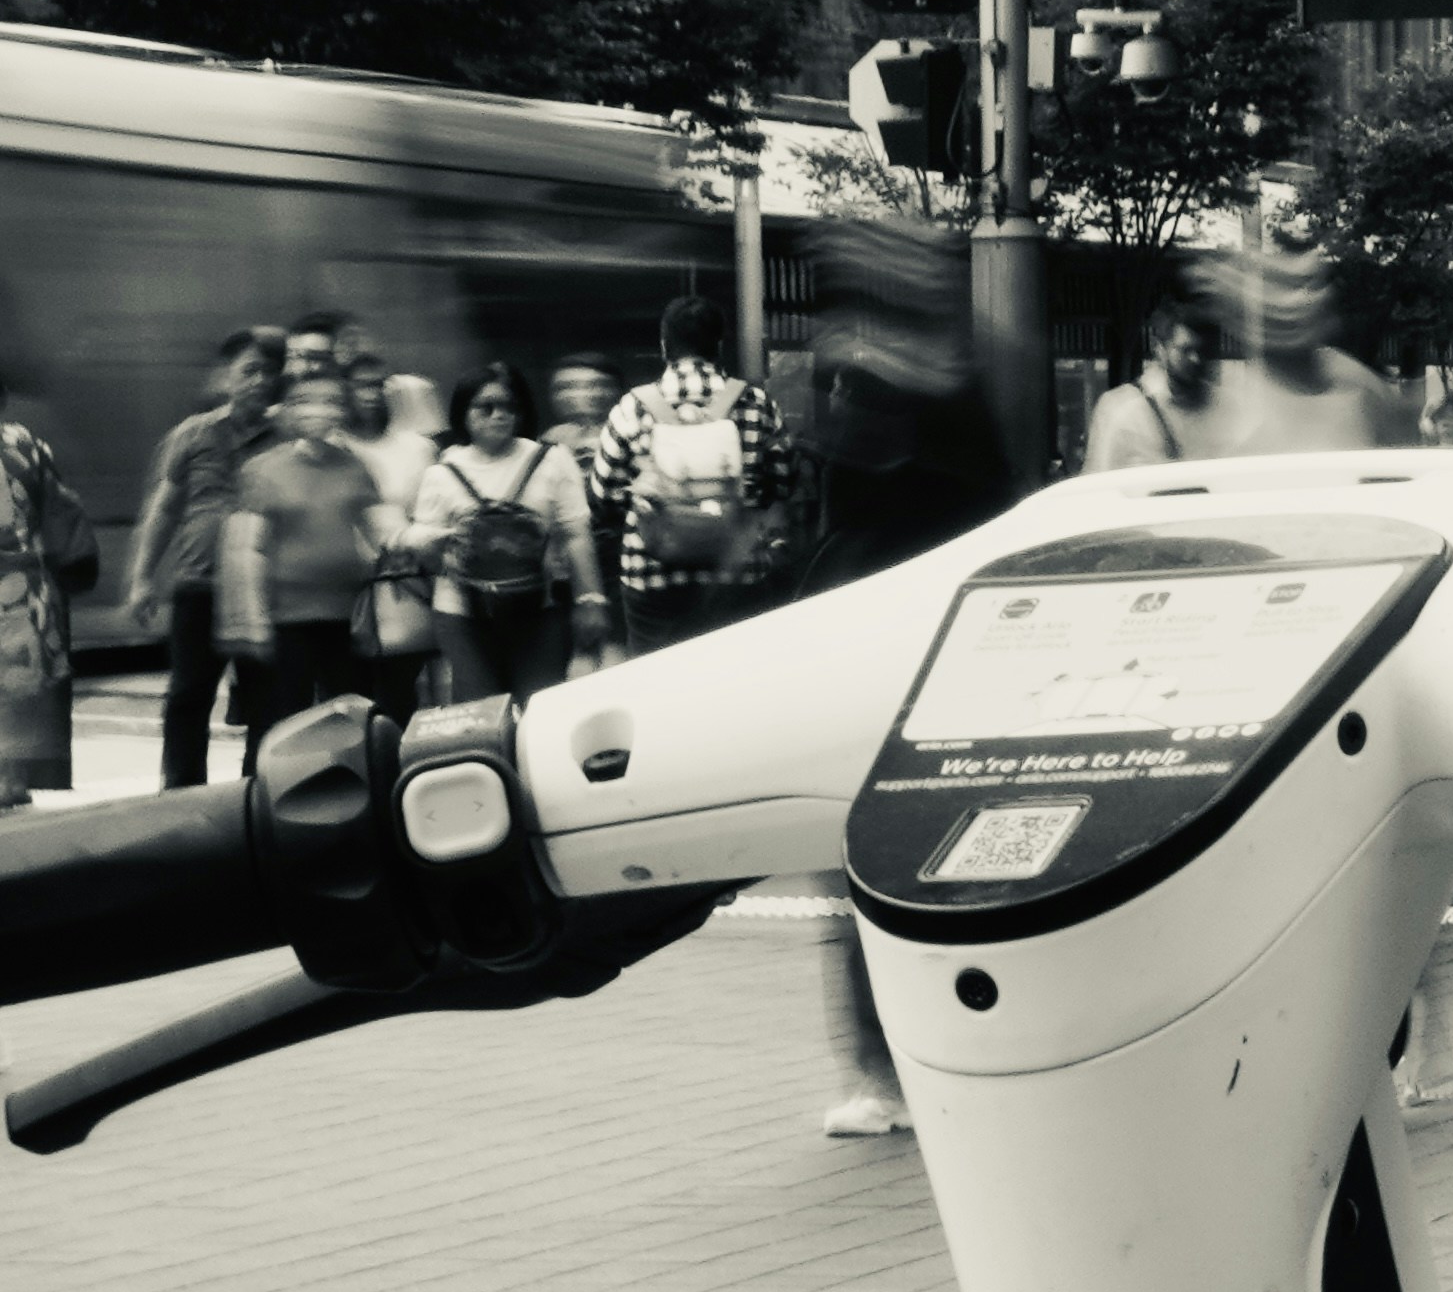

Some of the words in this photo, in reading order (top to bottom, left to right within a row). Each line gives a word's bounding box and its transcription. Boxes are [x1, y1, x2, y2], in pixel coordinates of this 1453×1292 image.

[939, 757, 1018, 776] We're
[1020, 754, 1087, 772] Here
[1091, 752, 1121, 768] to
[1124, 748, 1188, 769] Help
